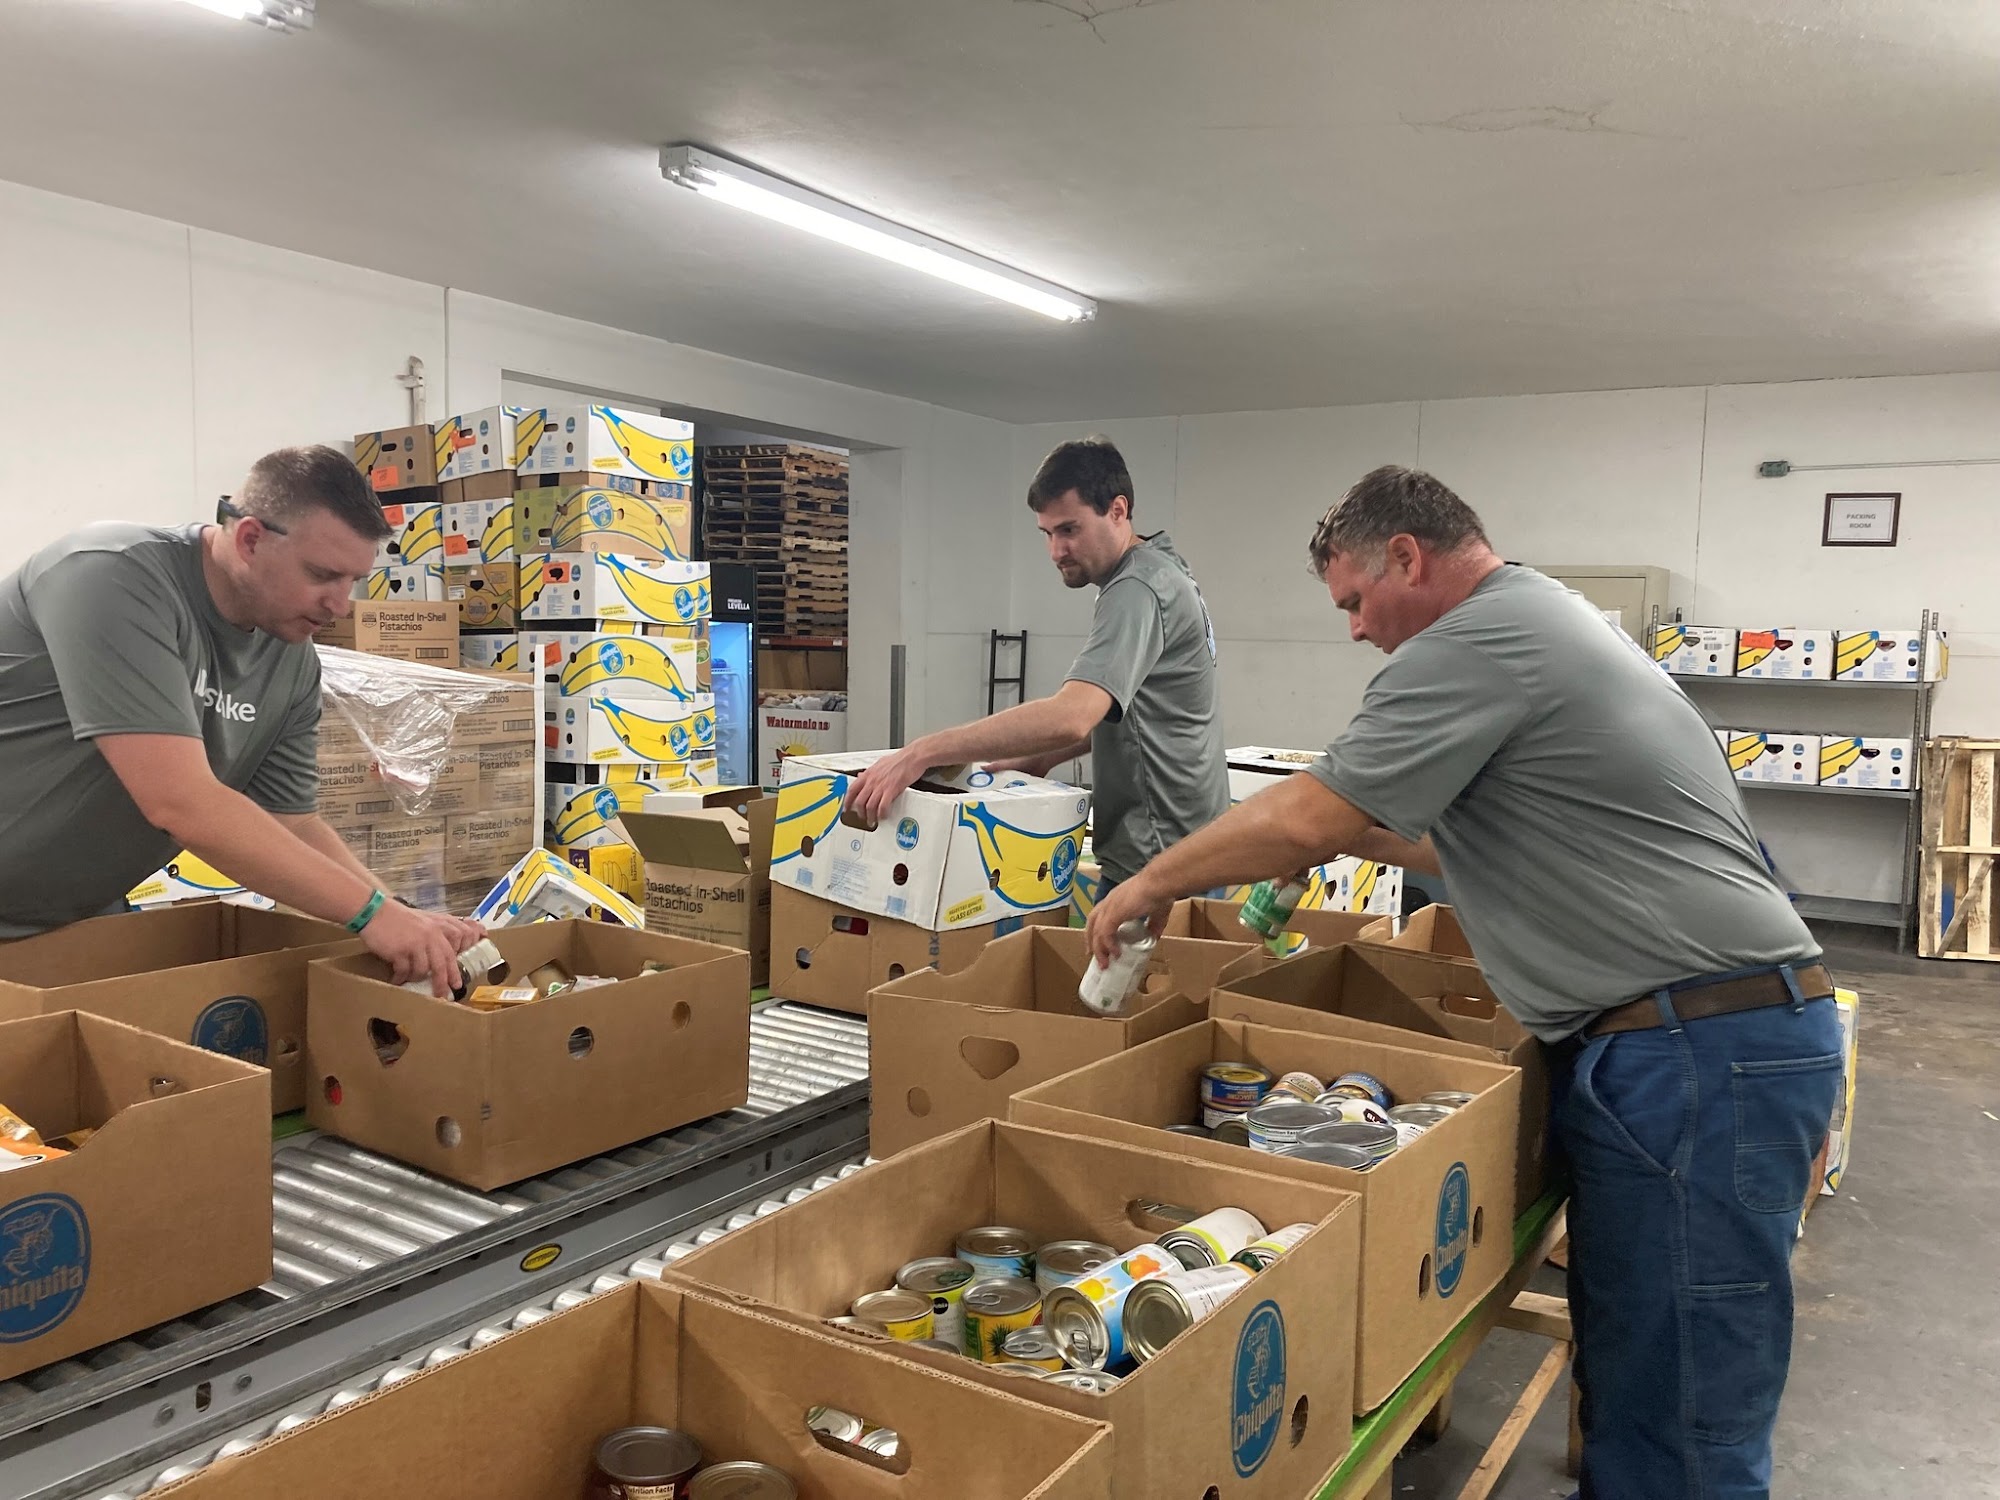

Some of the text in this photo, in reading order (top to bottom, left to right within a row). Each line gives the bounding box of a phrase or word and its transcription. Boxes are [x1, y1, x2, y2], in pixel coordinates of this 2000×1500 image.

[728, 602, 750, 610] LEVELLA
[380, 612, 446, 621] Roasted In-Shell
[380, 622, 422, 631] Pistachios
[766, 716, 830, 731] Watermelons
[314, 763, 354, 775] Roasted
[480, 761, 520, 770] Pistachios
[320, 776, 364, 786] istachios
[470, 816, 532, 831] Roasted In-Shell
[376, 824, 444, 840] Roasted In-Shell
[470, 830, 510, 840] Pistachios
[376, 838, 420, 850] Pistachios
[646, 878, 745, 903] Roasted In-Shell
[646, 892, 704, 913] Pistachios
[950, 904, 982, 923] CLASS EXTRA
[1234, 1383, 1283, 1450] Chiquita
[624, 1486, 673, 1494] utrition Facts
